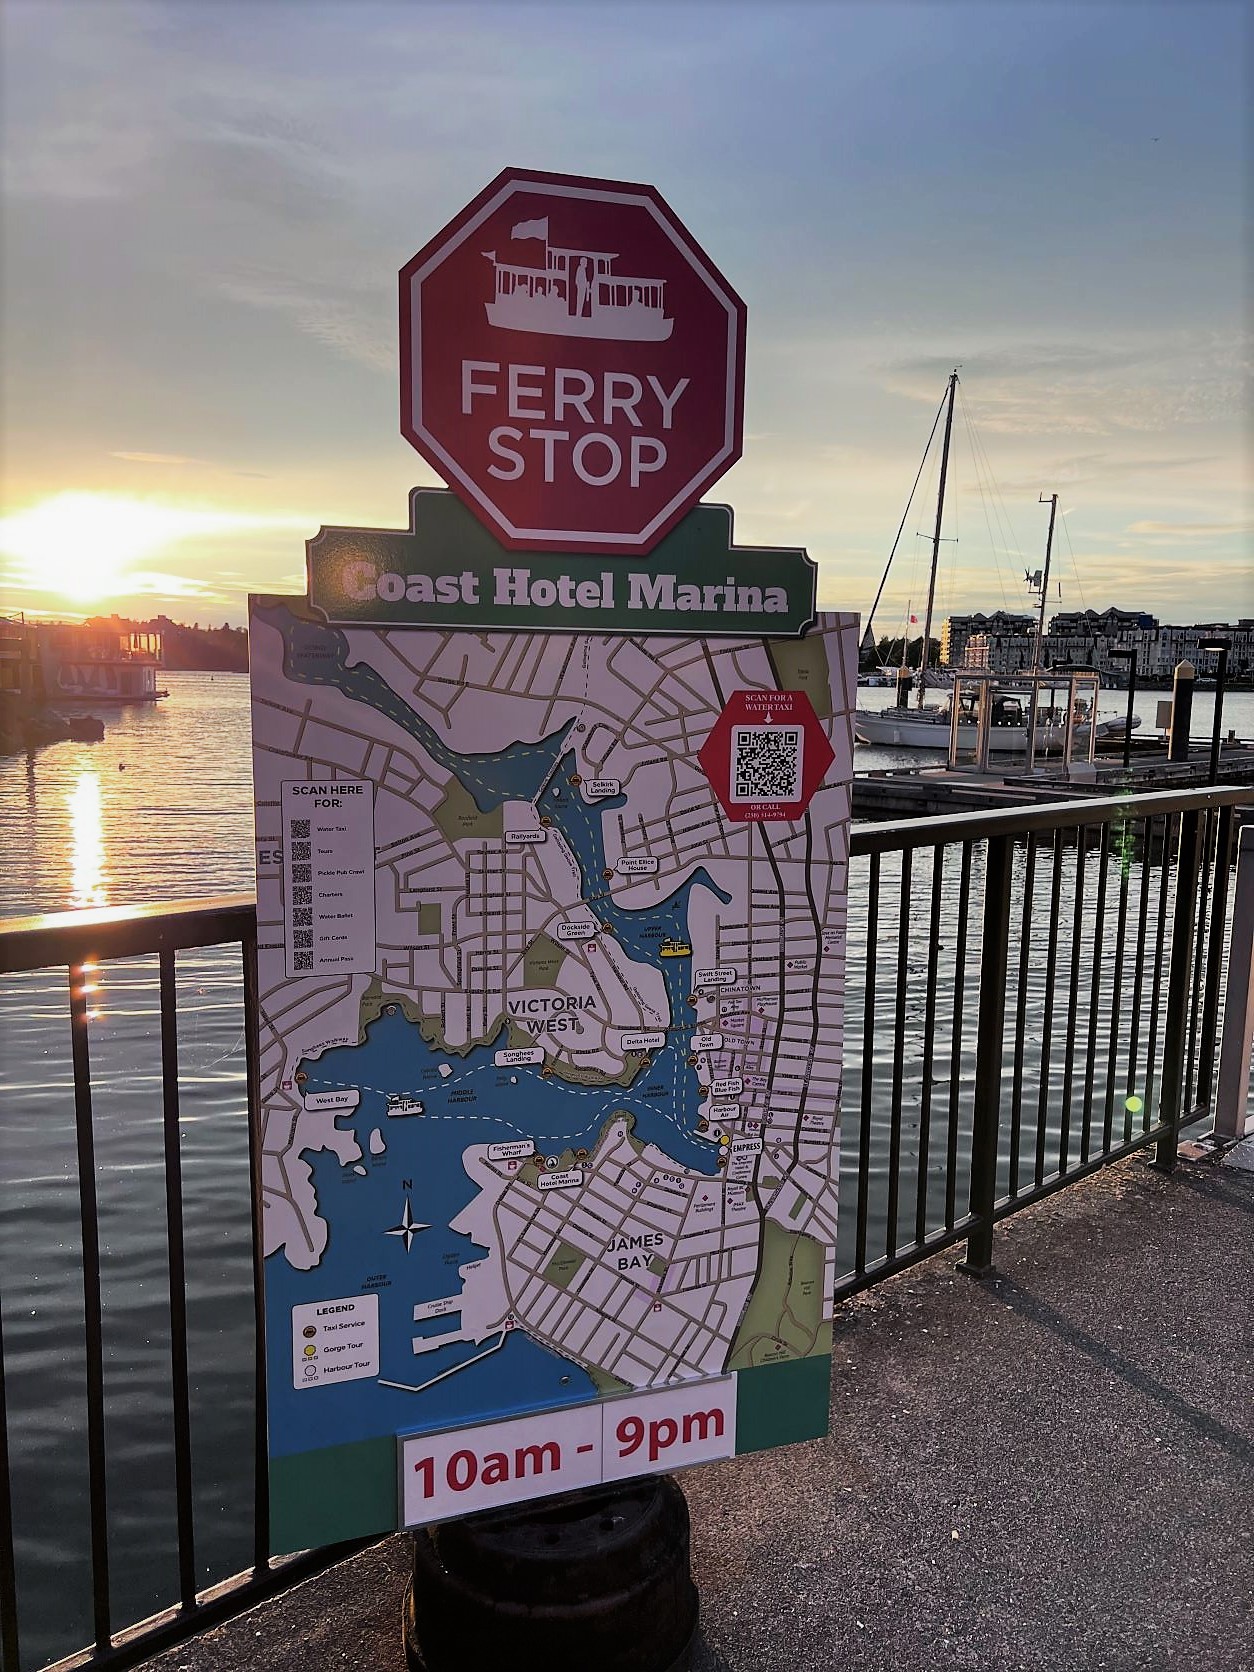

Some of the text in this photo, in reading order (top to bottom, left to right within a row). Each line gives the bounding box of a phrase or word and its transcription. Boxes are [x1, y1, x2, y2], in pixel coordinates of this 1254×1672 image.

[461, 359, 691, 429] FERRY
[486, 426, 668, 488] STOP
[343, 561, 789, 613] Coast Hotel Marina
[292, 786, 363, 795] SCAN HERE
[314, 799, 343, 808] FOR:
[720, 985, 761, 993] CHINATOWN
[509, 995, 597, 1014] VICTORIA
[527, 1017, 579, 1034] WEST
[503, 1050, 534, 1059] Songhees
[336, 1096, 348, 1104] Bay
[733, 1142, 760, 1152] EMPRESS
[501, 1149, 522, 1157] Wharf
[403, 1179, 413, 1189] N
[607, 1233, 664, 1252] JAMES
[618, 1254, 654, 1271] BAY
[317, 1305, 355, 1316] LEGEND
[339, 1320, 365, 1330] Service
[323, 1344, 346, 1354] Gorge
[323, 1364, 353, 1374] Harbour
[414, 1441, 561, 1499] 10am
[616, 1408, 724, 1462] 9pm
